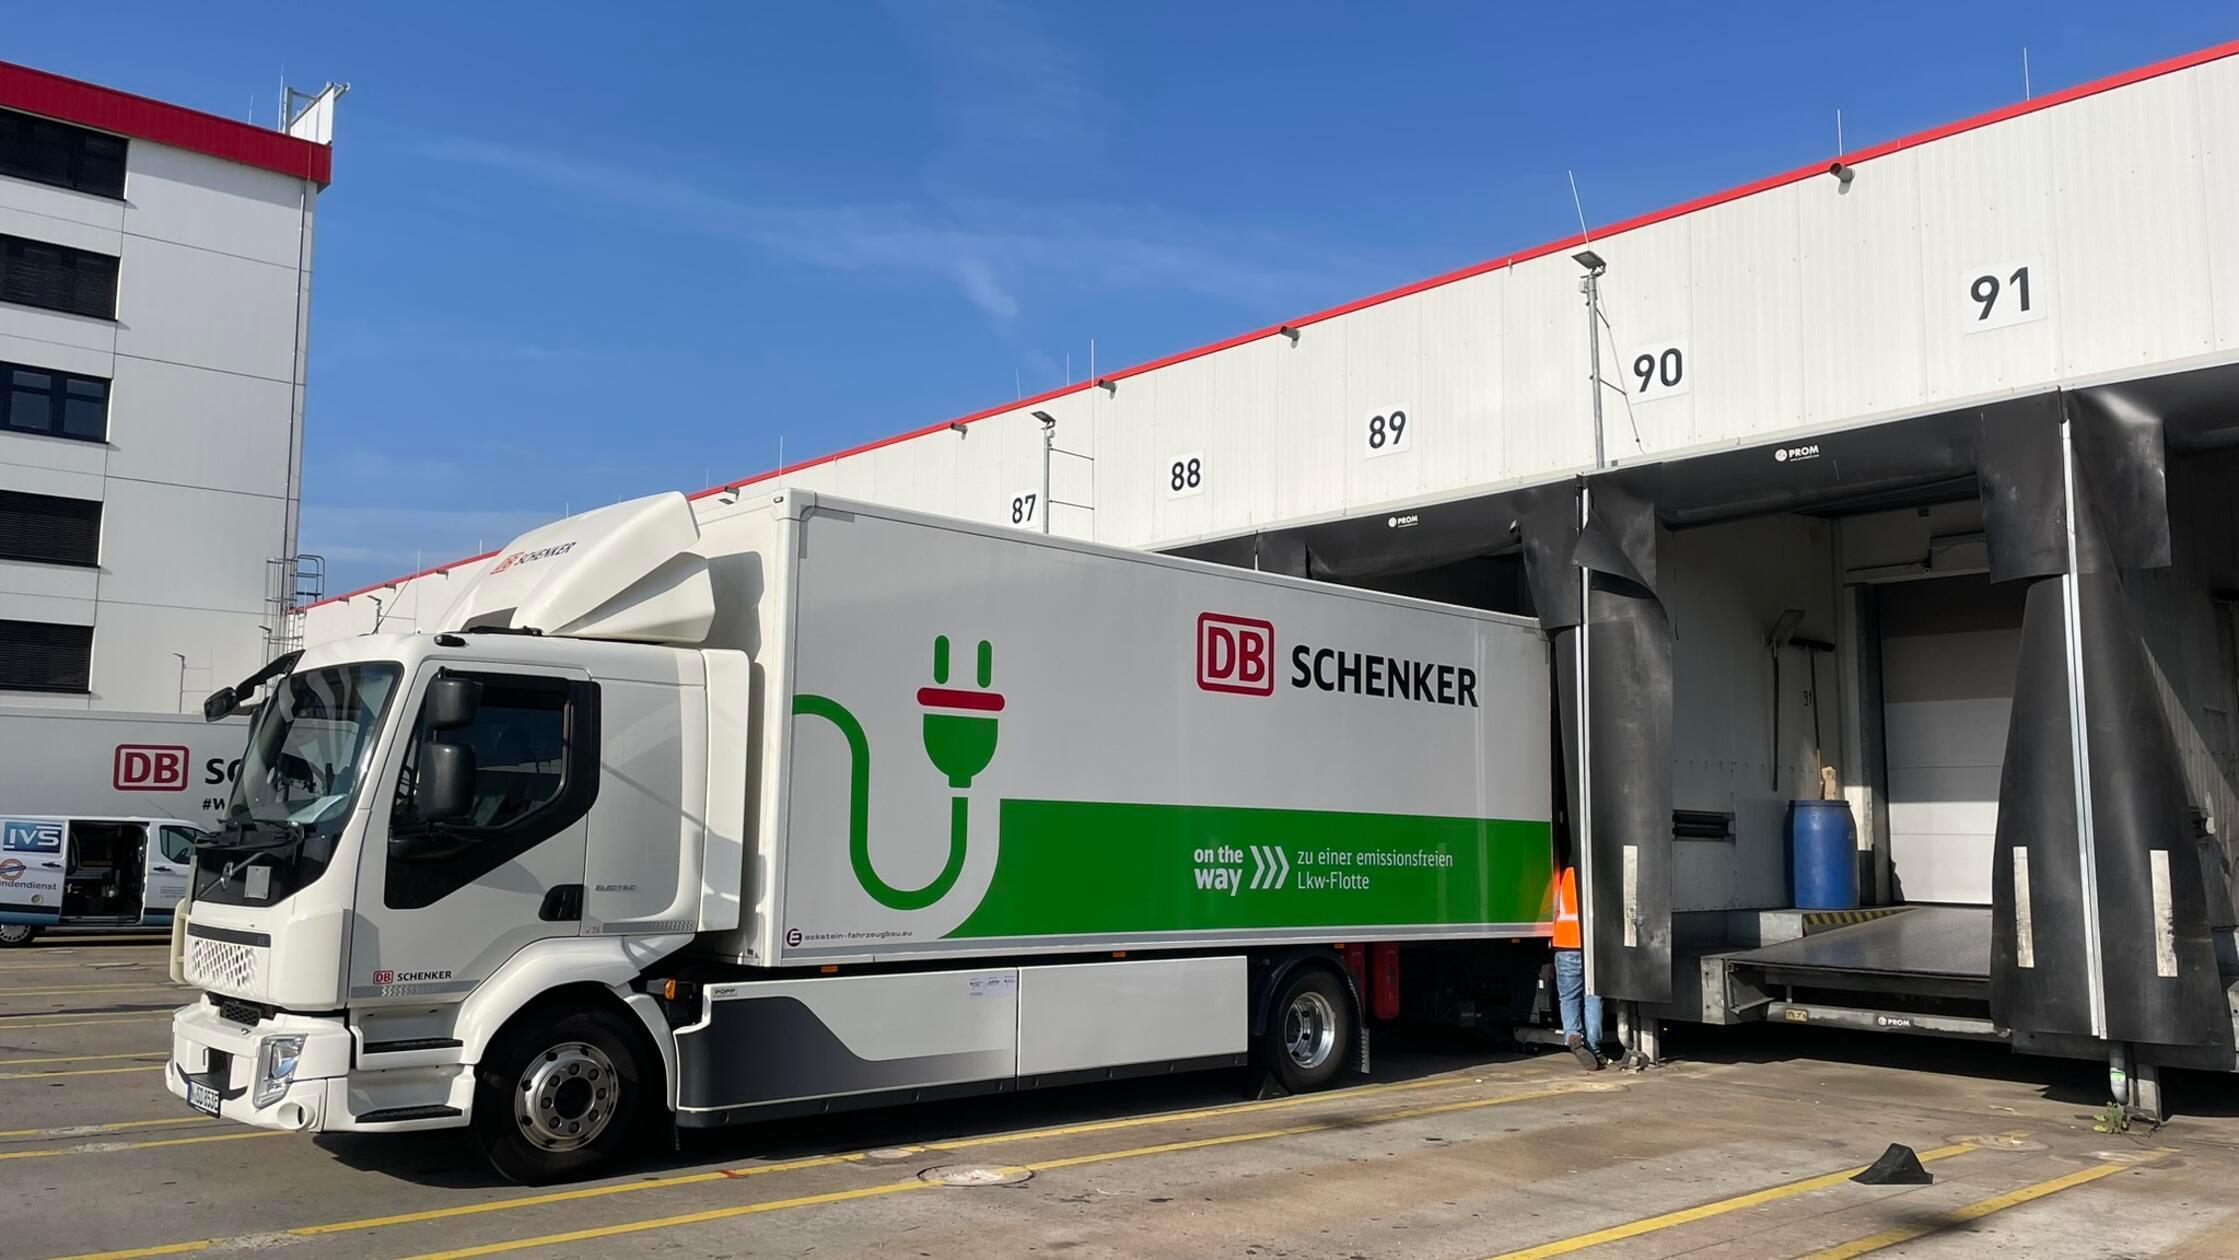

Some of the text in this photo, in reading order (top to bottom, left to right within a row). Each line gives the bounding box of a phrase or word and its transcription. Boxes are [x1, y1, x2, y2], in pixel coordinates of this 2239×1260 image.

[1970, 266, 2030, 321] 91
[1633, 347, 1683, 393] 90
[1369, 410, 1406, 449] 89
[1789, 445, 1819, 458] PROM
[1171, 458, 1201, 491] 88
[1012, 494, 1036, 524] 87
[1397, 515, 1418, 525] PROM
[1208, 626, 1479, 707] DB SCHENKER
[123, 752, 180, 784] DB
[9, 828, 60, 847] IVS
[1194, 845, 1244, 863] on the
[1297, 847, 1453, 868] zu einer emissionsfreien
[0, 880, 57, 890] ndendienst
[1194, 868, 1243, 896] way
[1297, 871, 1370, 890] Lkw-Flotte
[397, 970, 452, 982] SCHENKER
